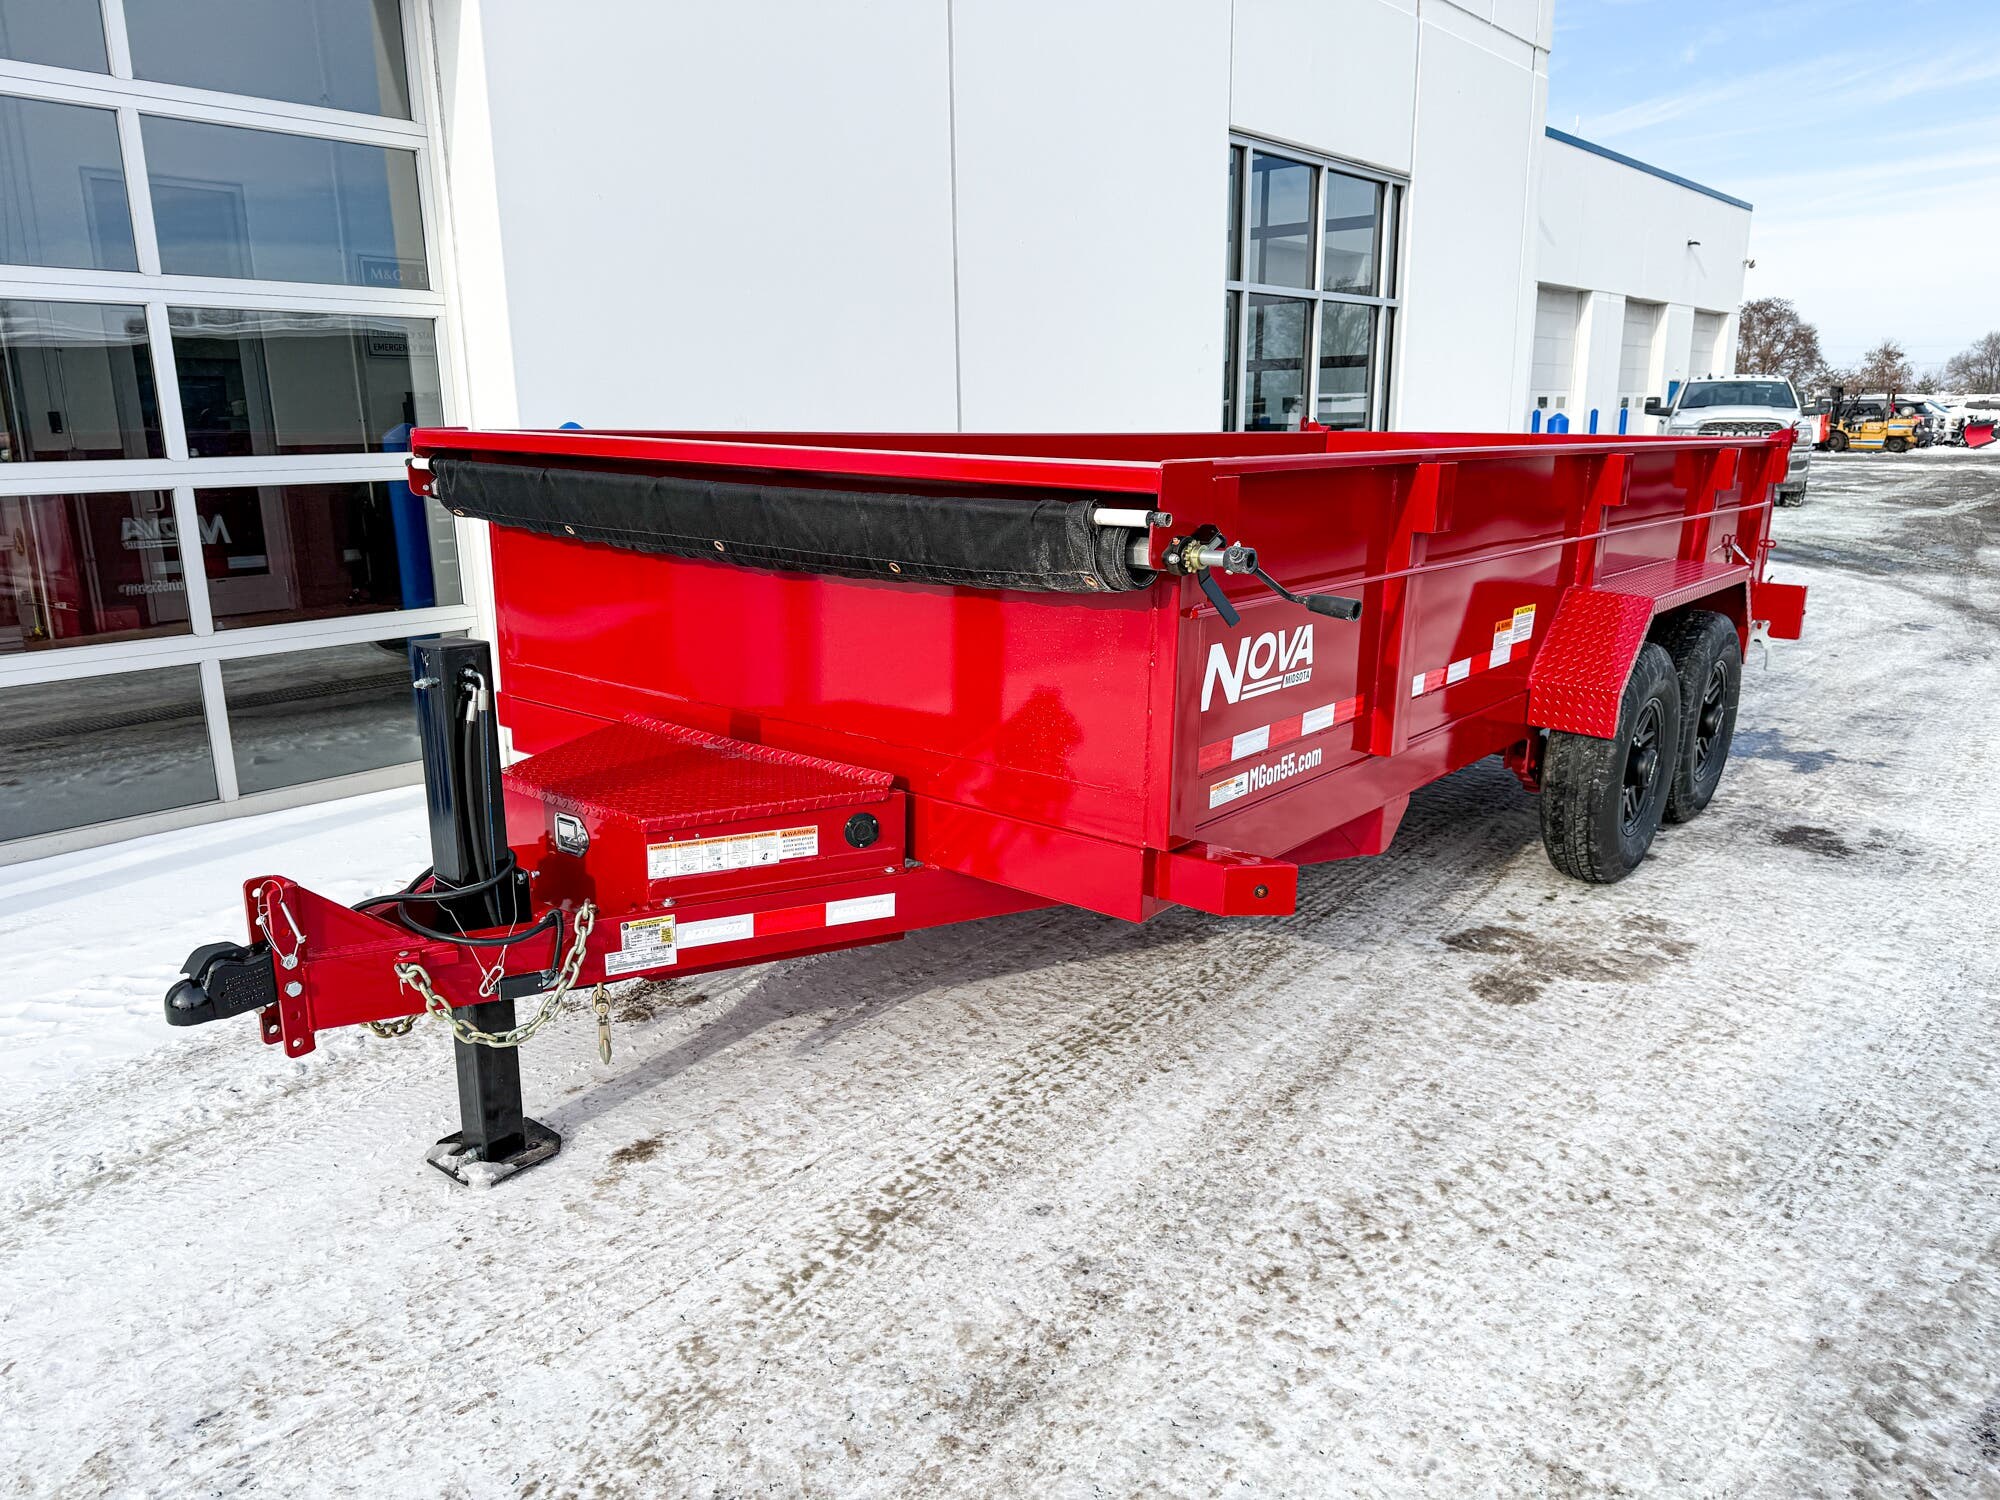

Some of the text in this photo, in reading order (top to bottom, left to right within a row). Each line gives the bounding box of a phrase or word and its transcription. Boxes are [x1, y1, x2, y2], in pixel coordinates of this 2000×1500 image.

[1722, 430, 1760, 438] RAM
[1200, 624, 1314, 713] NOVA
[1285, 670, 1310, 685] MIDSOTA
[1249, 748, 1322, 793] MGon55.com
[787, 828, 816, 837] WARNING
